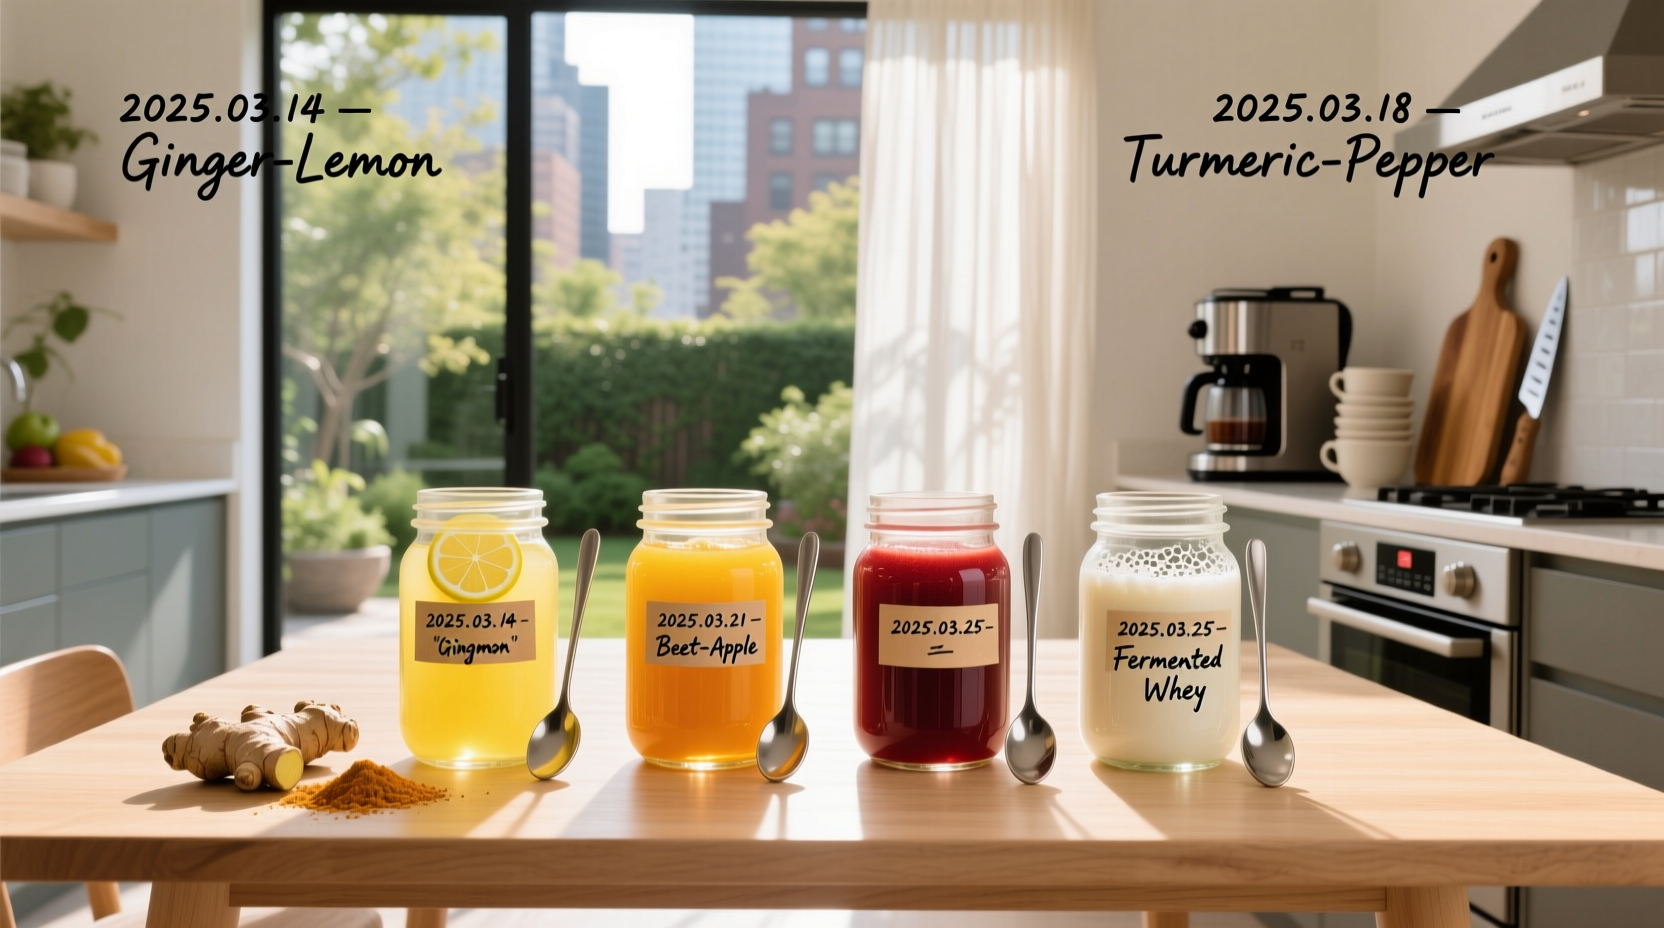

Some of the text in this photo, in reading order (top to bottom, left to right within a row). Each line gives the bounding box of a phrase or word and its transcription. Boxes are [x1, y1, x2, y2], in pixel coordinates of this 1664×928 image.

[655, 633, 758, 665] Beet-Apple
[1113, 643, 1224, 672] Fermented
[1144, 674, 1207, 713] Whey
